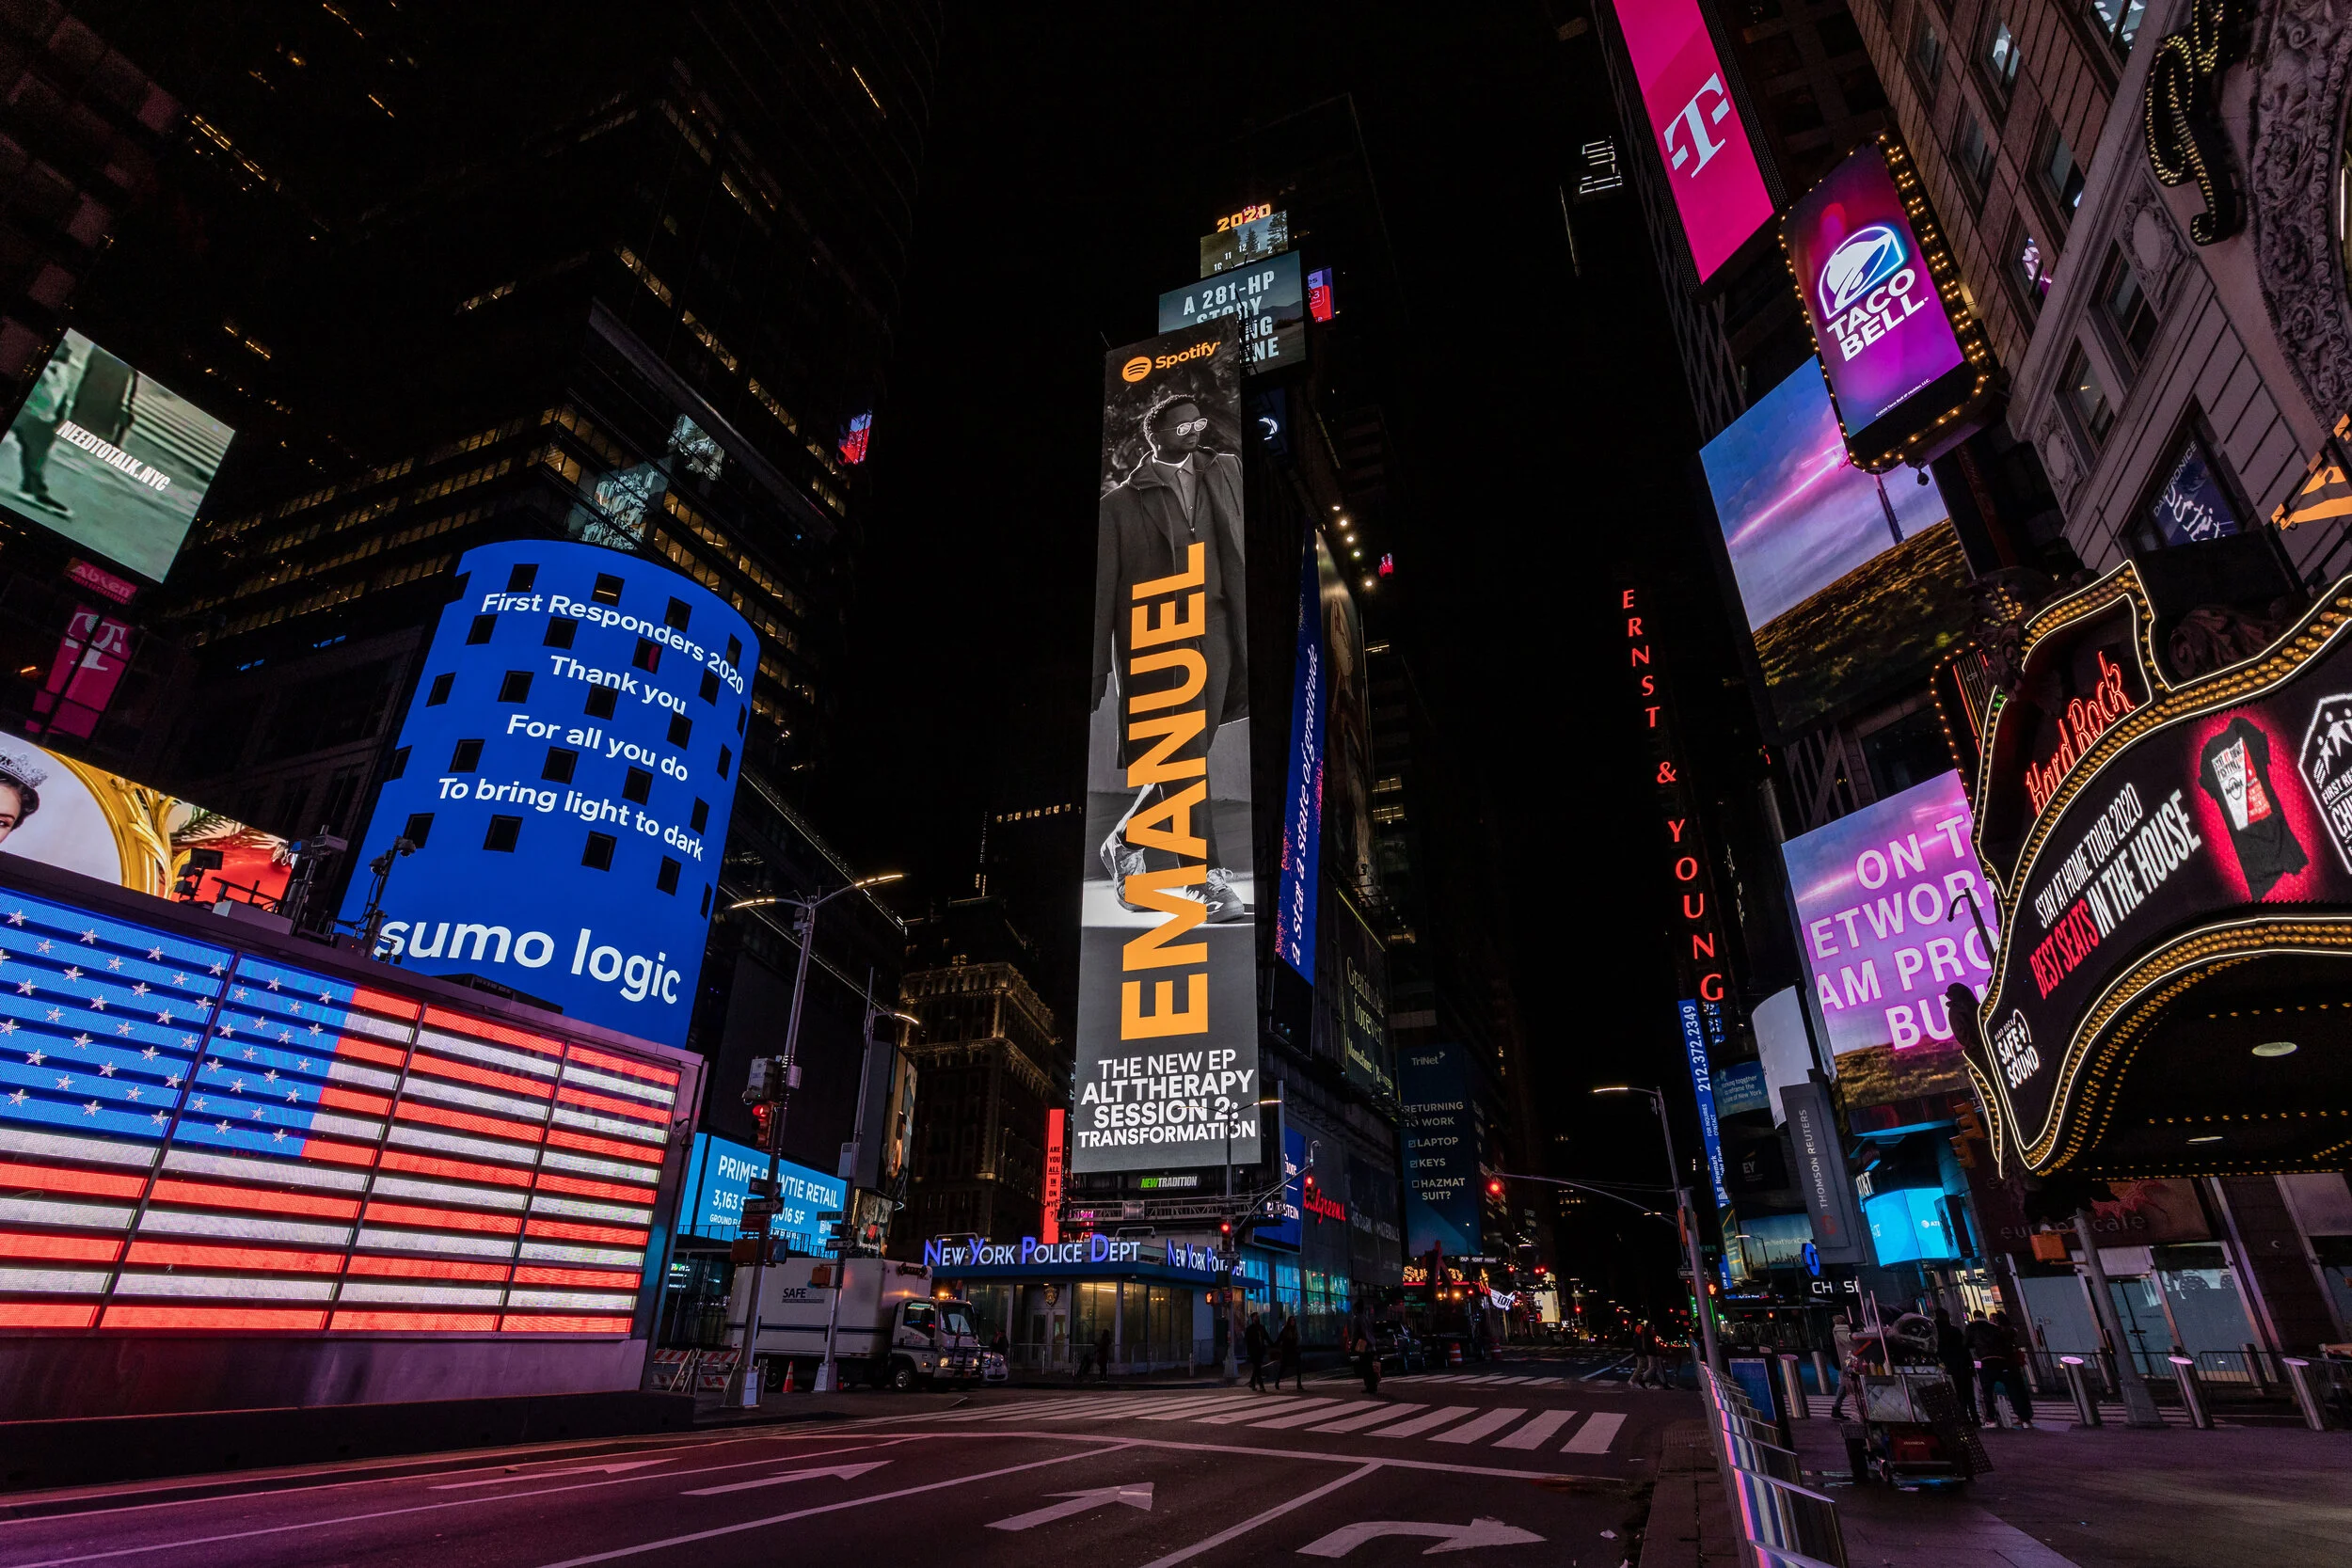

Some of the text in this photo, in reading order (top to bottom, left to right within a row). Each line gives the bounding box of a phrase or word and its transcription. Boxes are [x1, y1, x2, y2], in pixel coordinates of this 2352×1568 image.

[1216, 203, 1270, 232] 2020
[1224, 251, 1232, 261] 11
[1239, 244, 1247, 253] 12
[1184, 296, 1195, 315] A
[1202, 271, 1275, 309] 281-HP
[1826, 268, 1915, 342] TACO
[1839, 298, 1926, 361] BELL
[1155, 341, 1218, 369] Spotify
[56, 420, 171, 491] NEEDTOTALK.NYC
[481, 594, 744, 696] First Responders 2020
[549, 655, 687, 715] Thank you
[1305, 643, 1318, 762] gratitude
[506, 714, 689, 783] For all you do
[2026, 651, 2136, 817] Hard Rock
[1301, 742, 1313, 784] of
[1120, 542, 1209, 1040] EMANUEL
[1623, 589, 1661, 728] ERNST
[1656, 761, 1677, 784] &
[1667, 818, 1724, 1002] YOUNG
[2321, 778, 2344, 805] FIRST
[437, 778, 704, 863] To bring light to dark
[1297, 785, 1310, 856] state
[1295, 858, 1305, 879] a
[1855, 833, 1926, 891] ON
[2034, 782, 2143, 929] STAY AT HOME TOUR 2020
[1809, 869, 1995, 960] ETWOR
[2029, 788, 2202, 1001] BEST SEATS IN THE HOUSE
[373, 919, 681, 1005] sumo logic
[1346, 957, 1384, 1018] Gratitude
[1353, 993, 1382, 1046] forever
[1098, 1049, 1236, 1080] THE NEW EP
[1411, 1054, 1439, 1066] TriNet
[1682, 1006, 1711, 1092] 212.372.2349
[2007, 1044, 2040, 1089] SOUND
[1081, 1069, 1255, 1105] ALT THERAPY
[1404, 1101, 1464, 1114] RETURNING
[1077, 1120, 1256, 1148] TRANSFORMATION
[1093, 1097, 1239, 1129] SESSION 2:
[1422, 1117, 1454, 1127] WORK
[1417, 1136, 1459, 1148] LAPTOP
[1419, 1158, 1446, 1167] KEYS
[1799, 1109, 1828, 1209] THOMSON REUTERS
[718, 1154, 838, 1209] PRIME BWTIE RETAIL
[1421, 1178, 1466, 1188] HAZMAT
[1711, 1155, 1722, 1184] Newmark
[1855, 1171, 1874, 1197] AT&T
[712, 1189, 739, 1212] 3,163
[793, 1209, 805, 1225] SF
[1422, 1191, 1452, 1200] SUIT?
[709, 1213, 732, 1227] GROUND
[924, 1233, 1141, 1266] NEW YORK POLICE DEPT
[1167, 1238, 1186, 1268] NEW
[1186, 1243, 1206, 1271] YORK
[783, 1288, 806, 1298] SAFE
